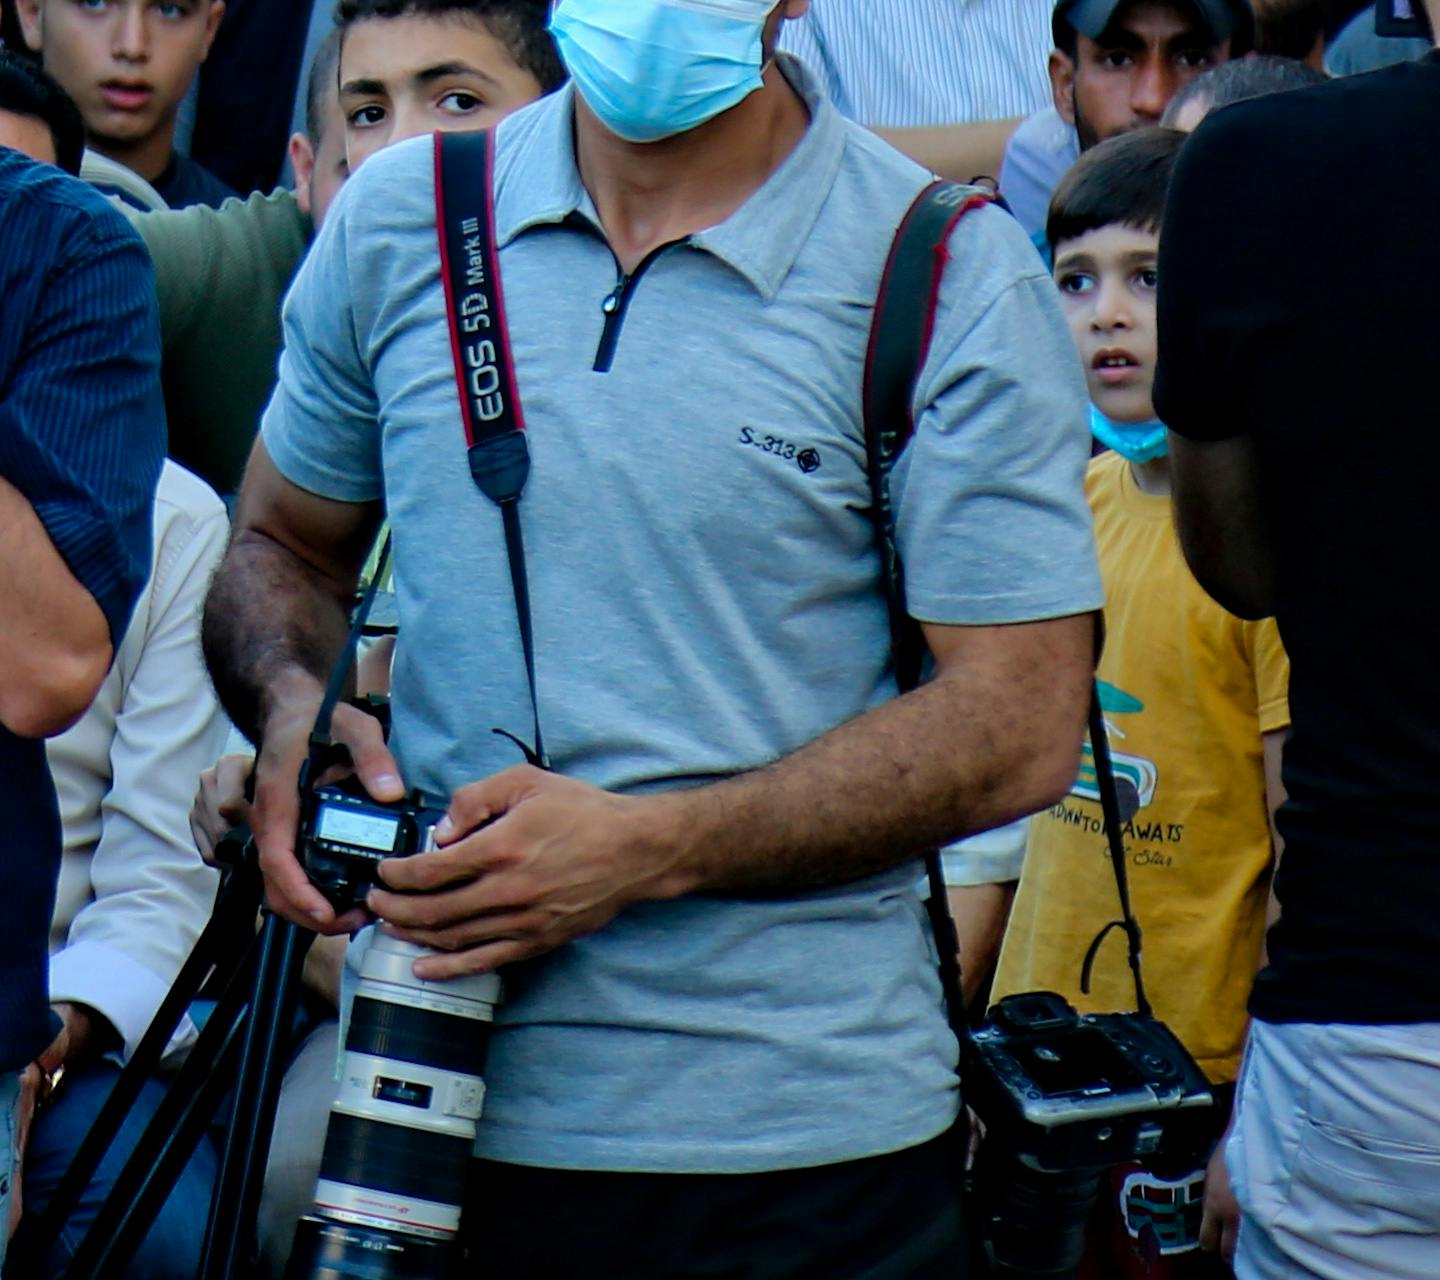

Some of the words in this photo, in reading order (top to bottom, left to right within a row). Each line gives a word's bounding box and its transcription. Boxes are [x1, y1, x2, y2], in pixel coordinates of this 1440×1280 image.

[463, 234, 486, 286] Mark
[461, 292, 491, 333] 5D
[467, 339, 504, 422] EOS
